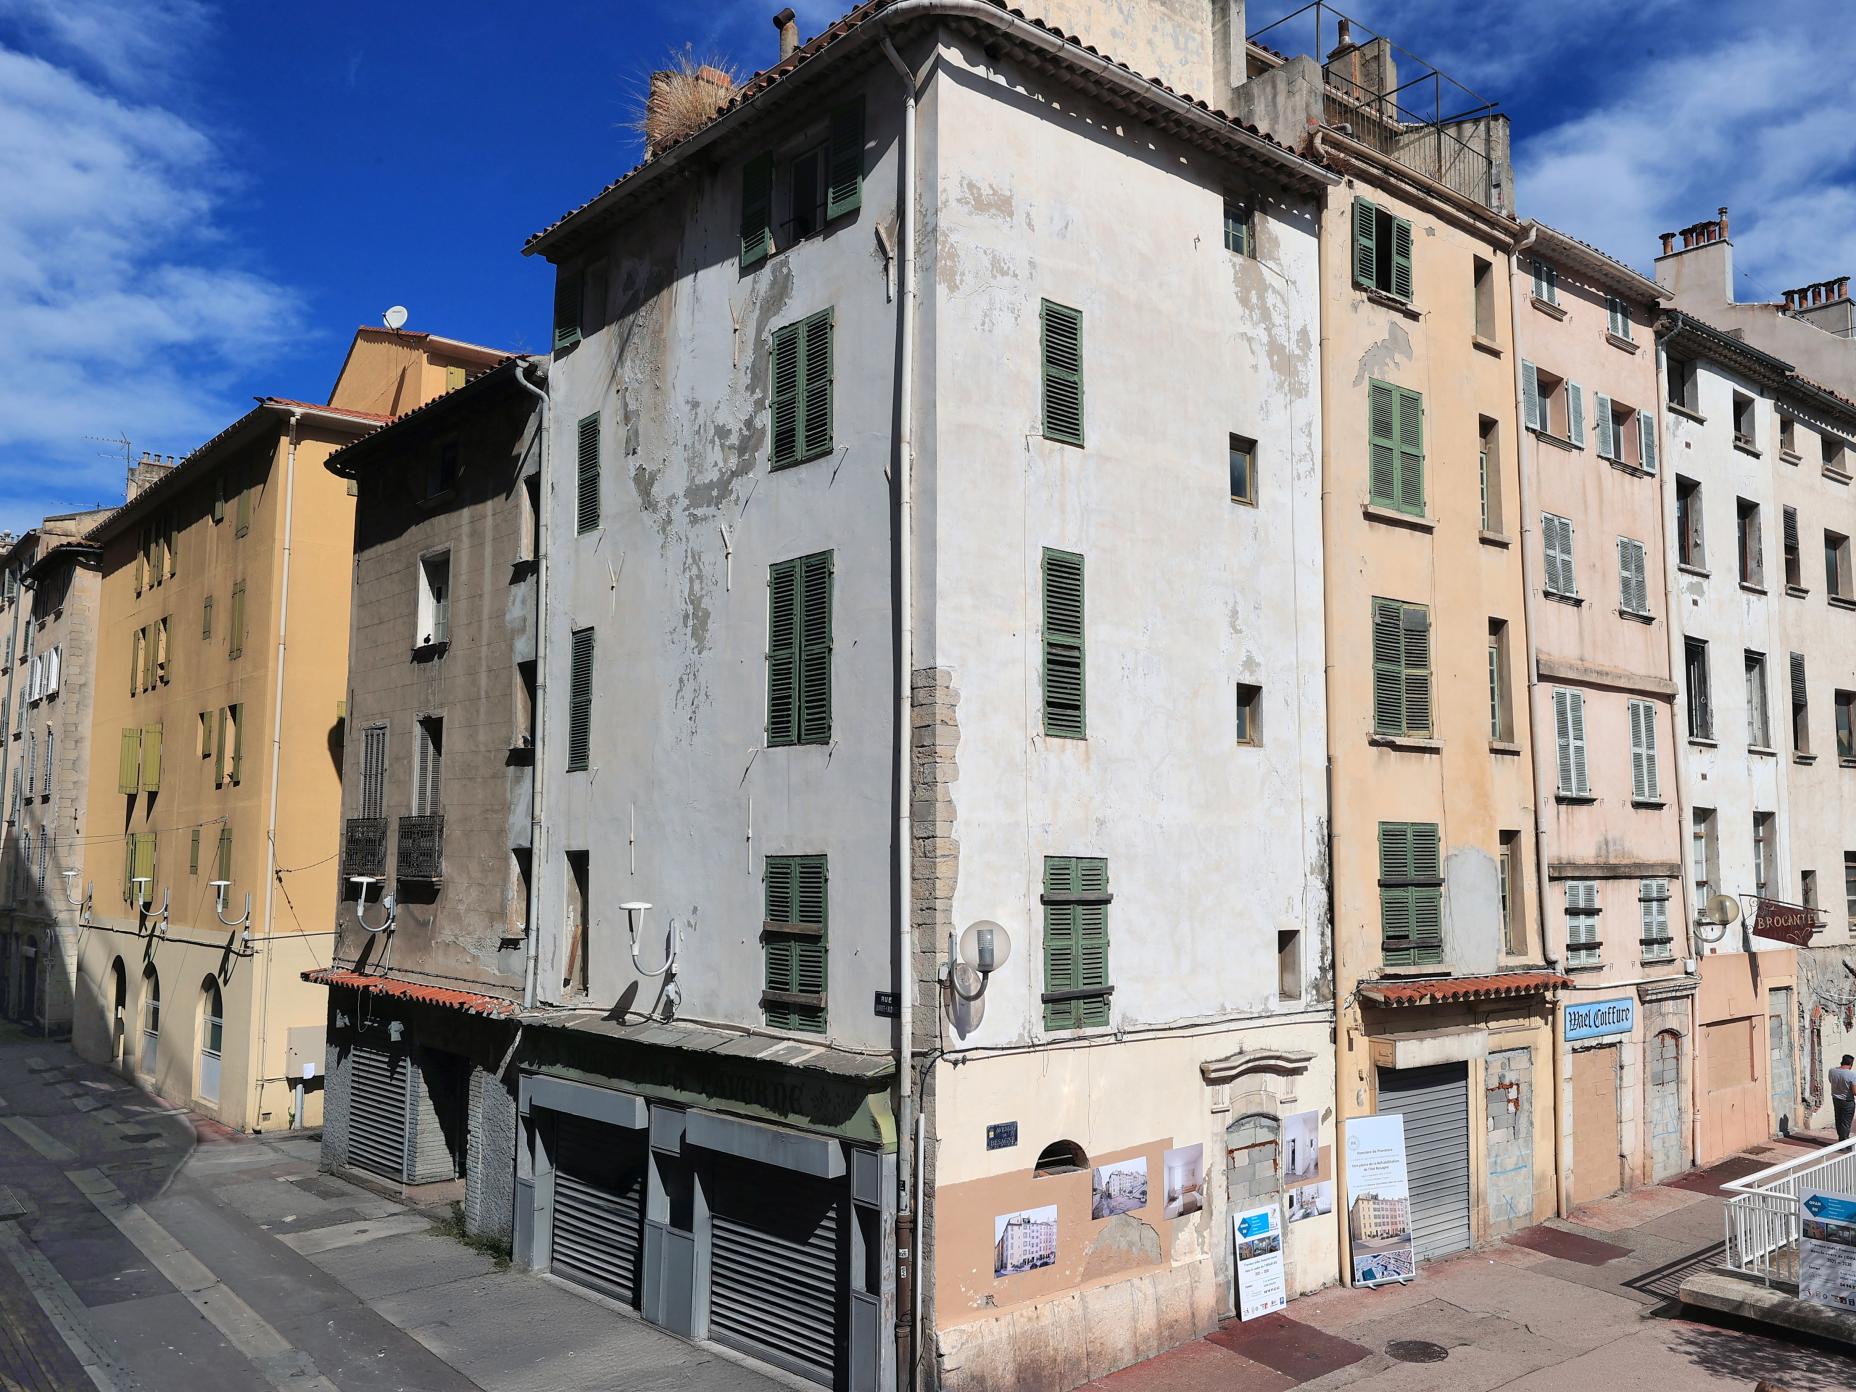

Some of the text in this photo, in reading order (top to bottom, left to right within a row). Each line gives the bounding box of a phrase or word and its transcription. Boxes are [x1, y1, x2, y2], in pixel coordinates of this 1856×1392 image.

[1757, 913, 1815, 929] BROCANTE
[1568, 1006, 1630, 1032] Wael Coiffure
